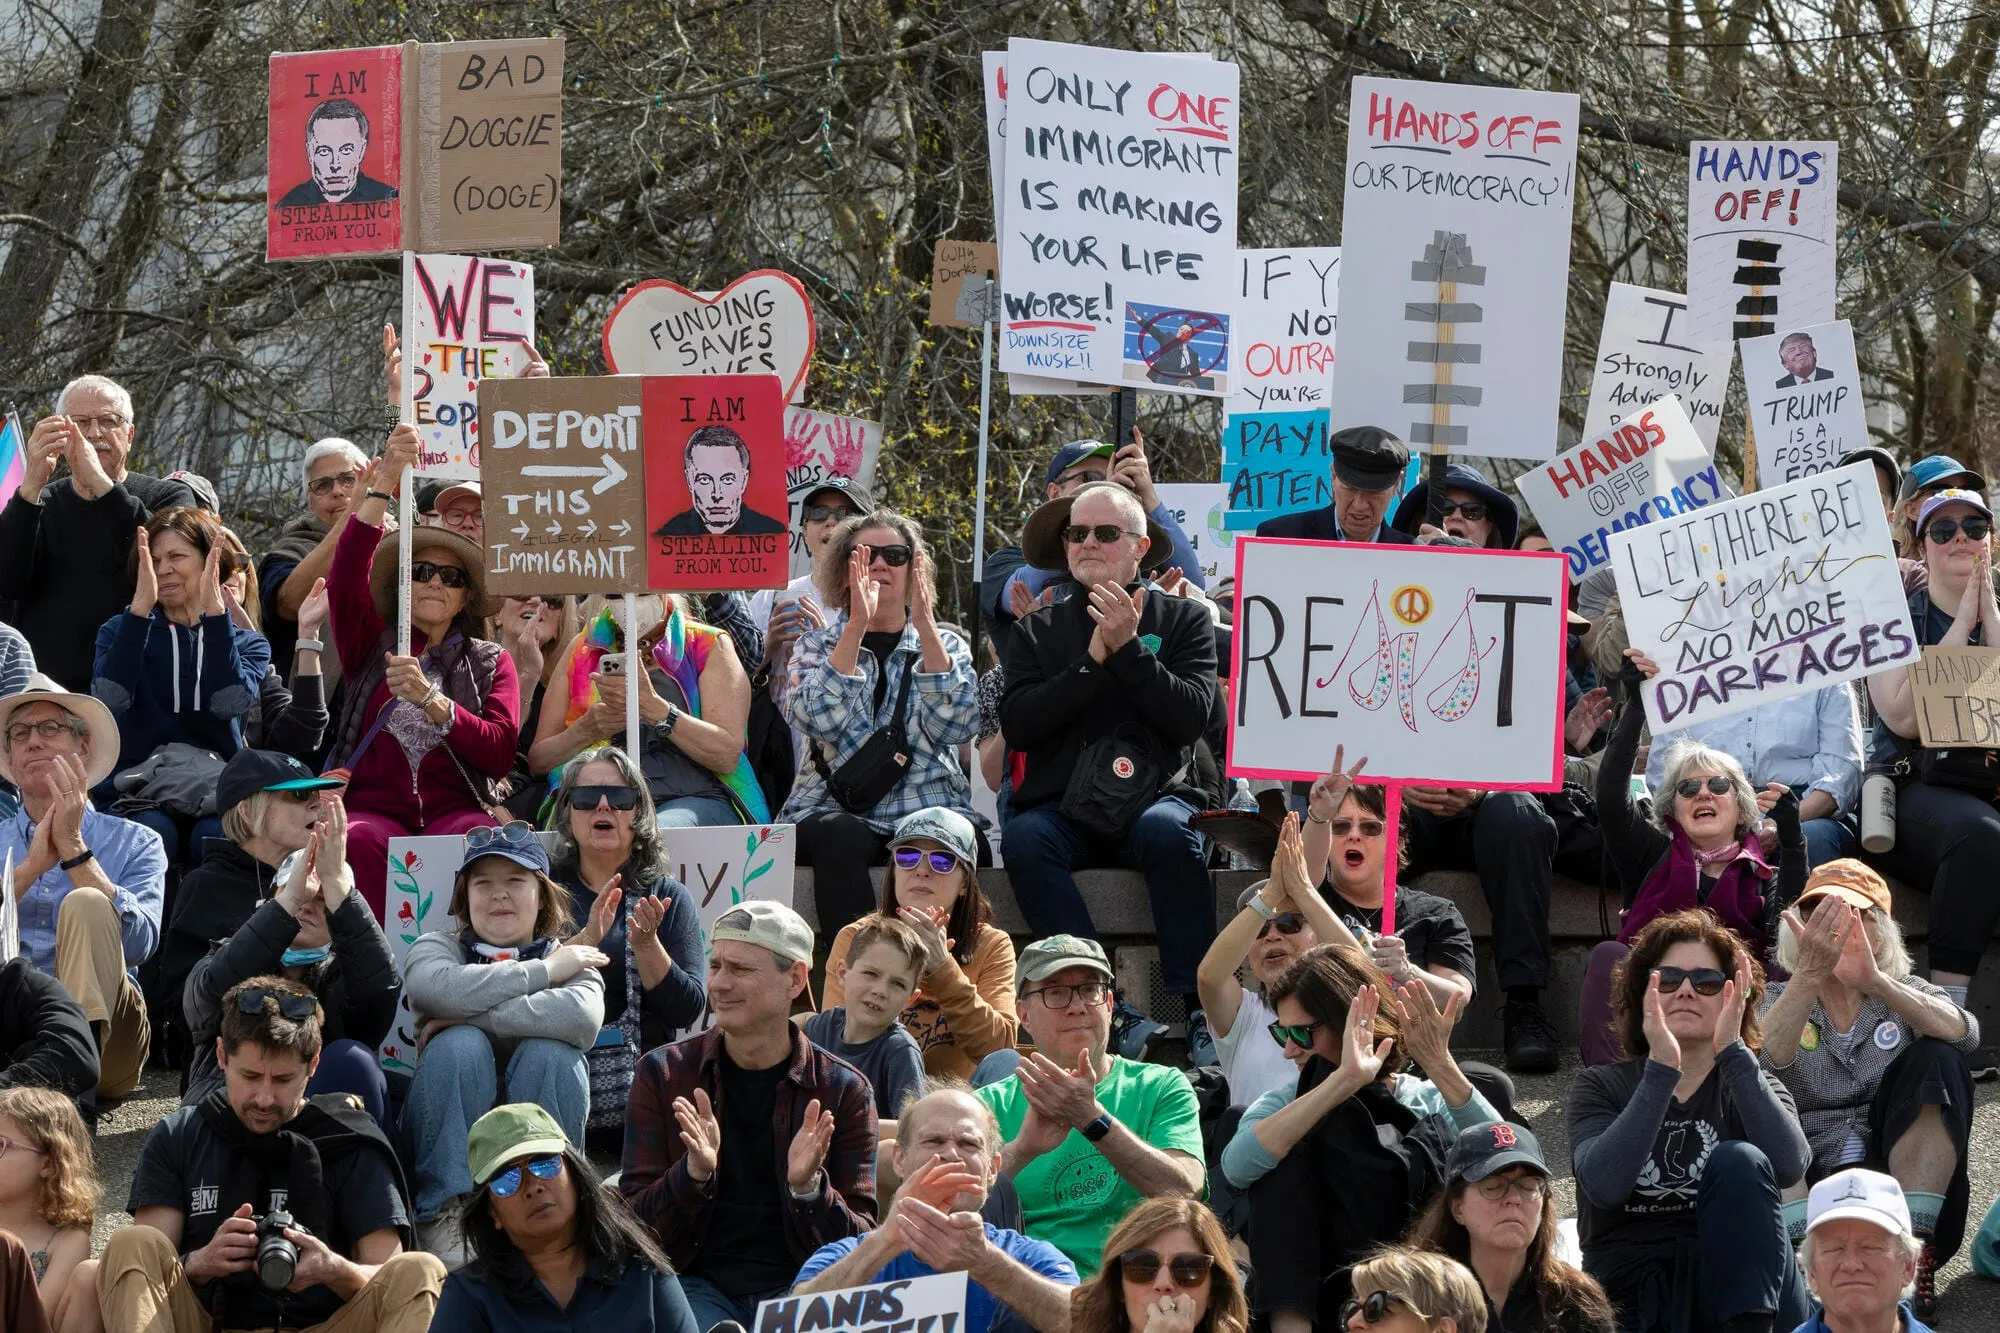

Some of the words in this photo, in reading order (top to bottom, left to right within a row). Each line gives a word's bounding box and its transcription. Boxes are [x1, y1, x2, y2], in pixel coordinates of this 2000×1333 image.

[304, 73, 320, 98] I
[328, 70, 368, 96] AM
[458, 54, 545, 90] BAD
[1026, 66, 1132, 116] ONLY
[1147, 82, 1232, 131] ONE
[440, 114, 556, 150] DOGGIE
[1368, 92, 1480, 149] HANDS
[1487, 115, 1562, 154] OFF
[1025, 124, 1233, 176] IMMIGRANT
[1696, 145, 1822, 185] HANDS
[453, 173, 558, 215] (DOGE)
[1352, 161, 1399, 190] OUR
[1402, 161, 1571, 209] DEMOCRACY!
[280, 201, 393, 227] STEALING
[1020, 177, 1059, 211] IS
[1078, 184, 1224, 233] MAKING
[1714, 188, 1801, 226] OFF!
[293, 226, 338, 243] FROM
[343, 223, 382, 239] YOU.
[1019, 232, 1108, 270] YOUR
[1121, 242, 1204, 281] LIFE
[1242, 255, 1292, 300] IF
[415, 256, 529, 343] WE
[1003, 281, 1113, 325] WORSE!
[650, 289, 776, 351] FUNDING
[1637, 297, 1704, 354] I
[678, 322, 773, 366] SAVES
[1006, 330, 1090, 351] DOWNSIZE
[1245, 342, 1335, 377] OUTRA
[428, 343, 499, 379] THE
[1026, 352, 1094, 372] MUSK!!
[1601, 352, 1708, 390] Strongly
[680, 397, 696, 423] I
[706, 396, 747, 421] AM
[1243, 386, 1324, 410] YOU'RE
[1690, 400, 1719, 423] you
[1763, 386, 1848, 425] TRUMP
[491, 406, 641, 452] DEPORT
[1240, 420, 1328, 457] PAYI
[1789, 427, 1805, 444] IS
[1816, 423, 1827, 438] A
[1546, 410, 1666, 499] HANDS
[1774, 437, 1851, 467] FOSSIL
[502, 489, 592, 516] THIS
[1228, 468, 1334, 510] ATTEN
[1587, 462, 1650, 518] OFF
[523, 532, 613, 547] ILLEGAL
[660, 535, 778, 556] STEALING
[1627, 520, 1700, 598] LET
[1704, 494, 1809, 570] THERE
[1811, 479, 1861, 538] BE
[490, 543, 636, 579] IMMIGRANT
[674, 558, 723, 574] FROM
[727, 556, 768, 573] YOU.
[1660, 543, 1887, 643] Light
[1676, 633, 1733, 672] NO
[1747, 591, 1847, 652] MORE
[1655, 652, 1788, 724] DARK
[1796, 619, 1913, 685] AGES
[1914, 655, 1996, 686] HANDS
[1922, 695, 2000, 744] LIBR
[1488, 1124, 1518, 1149] B
[1624, 1204, 1648, 1213] Left
[760, 1281, 913, 1333] HANDS
